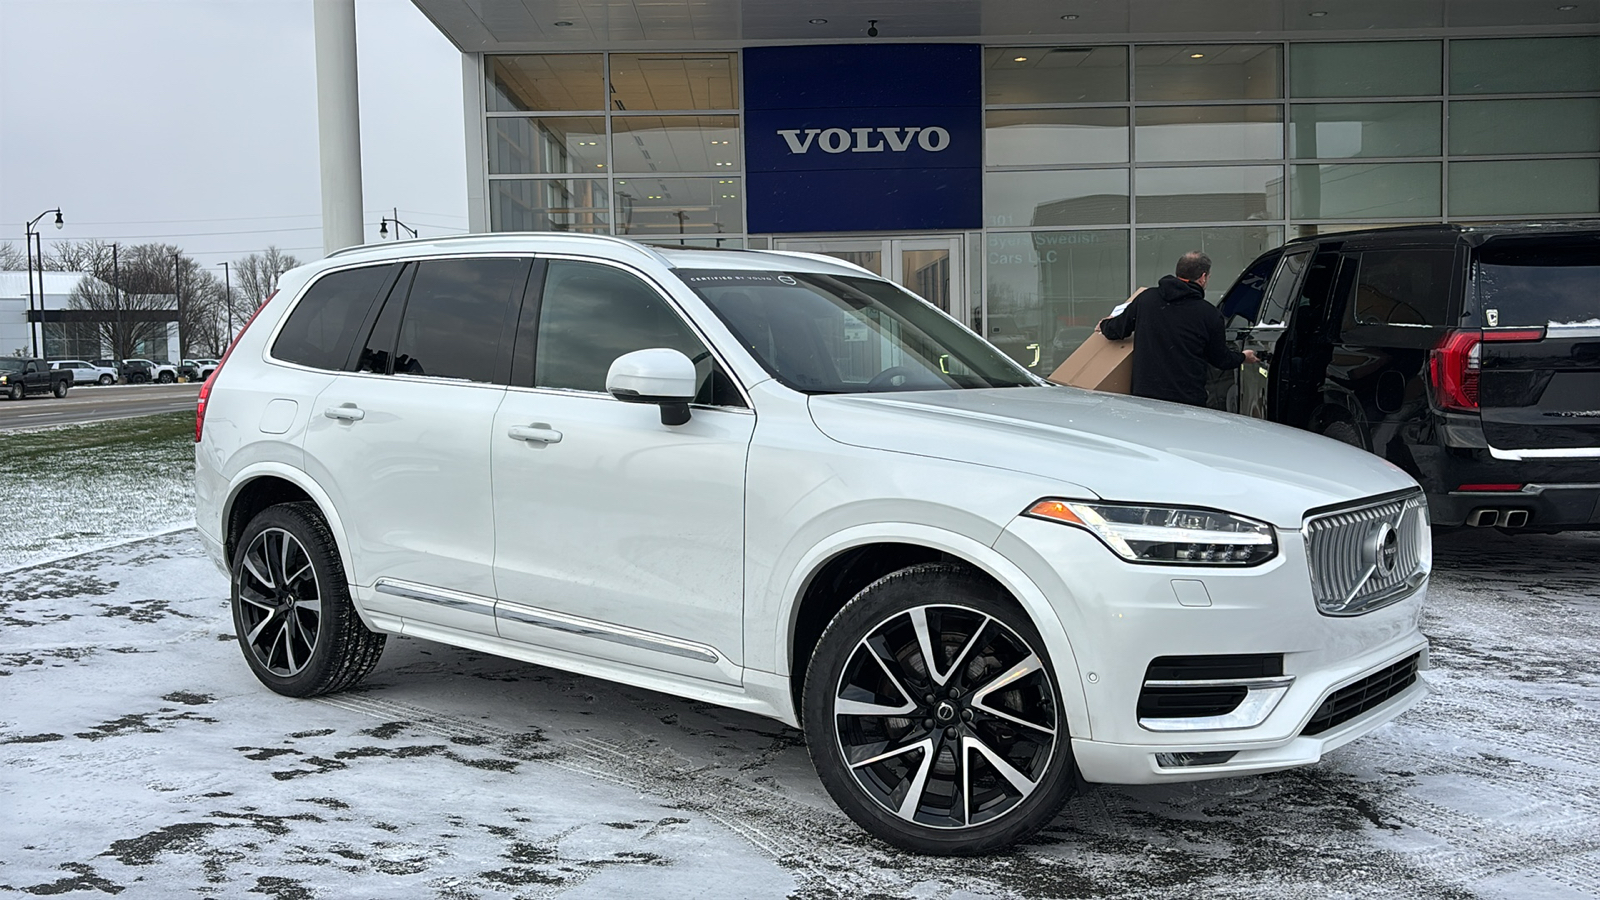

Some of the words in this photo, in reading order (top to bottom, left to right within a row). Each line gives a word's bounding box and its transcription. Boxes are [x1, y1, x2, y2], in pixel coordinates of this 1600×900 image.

[777, 126, 950, 154] VOLVO
[988, 234, 1031, 249] Byers
[1035, 232, 1099, 246] Swedish
[988, 251, 1022, 265] Cars
[1028, 249, 1058, 264] LLC
